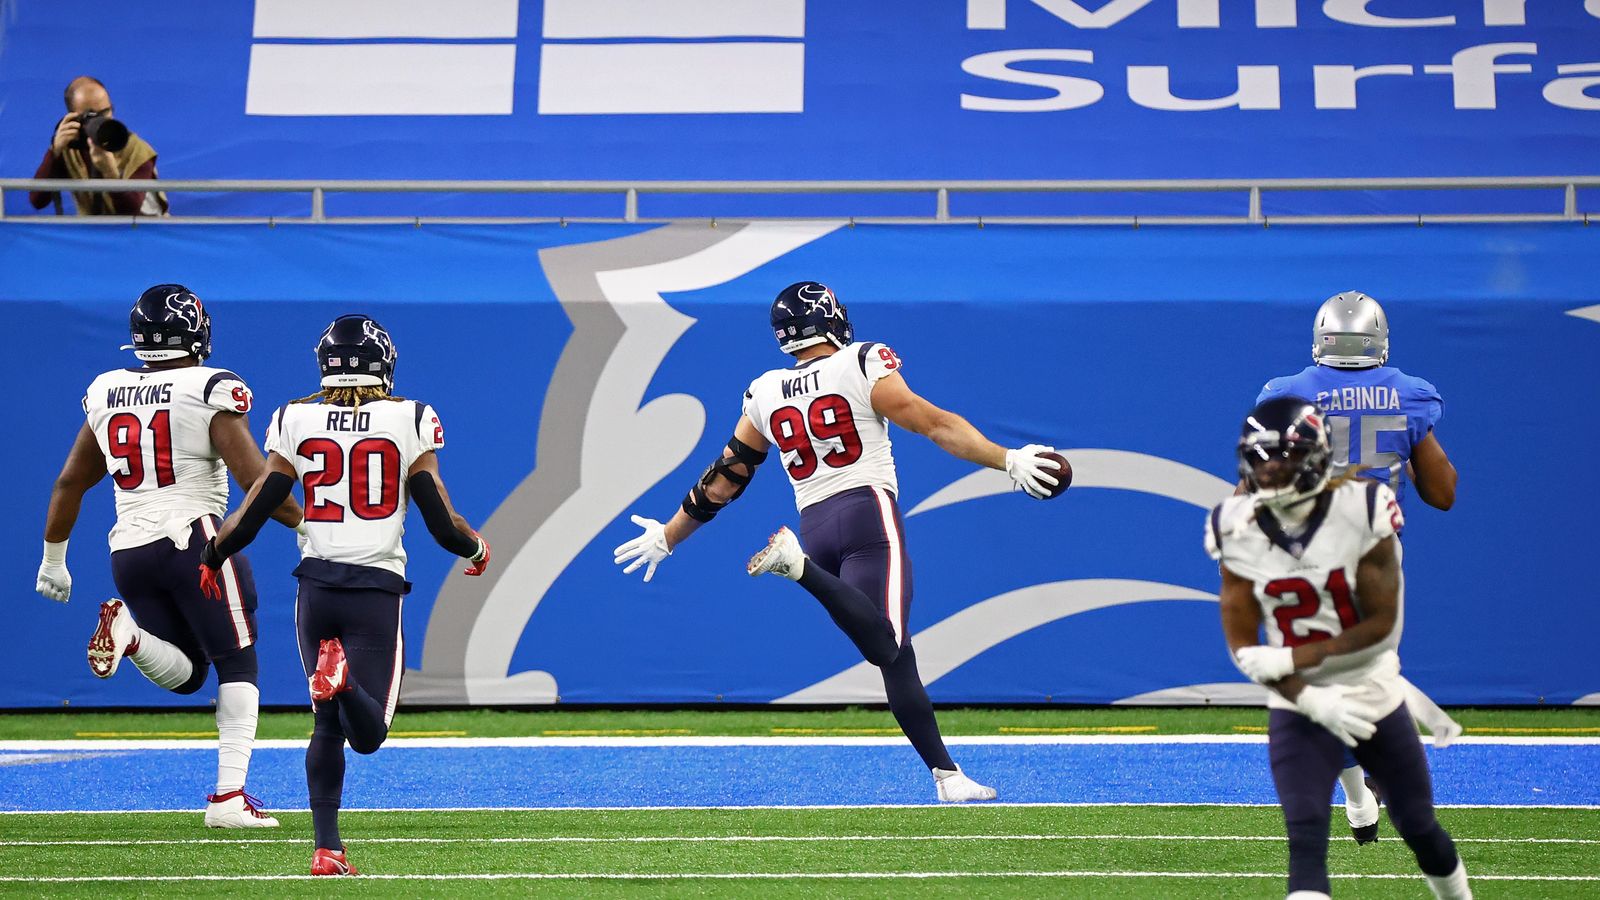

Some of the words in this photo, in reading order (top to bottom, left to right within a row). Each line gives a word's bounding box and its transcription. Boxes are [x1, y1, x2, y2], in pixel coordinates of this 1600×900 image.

[966, 0, 1600, 28] Micr
[878, 348, 902, 369] 9
[107, 383, 173, 408] WATKINS
[781, 370, 820, 399] WATT
[1317, 386, 1400, 411] CABINDA
[231, 386, 253, 412] 9
[326, 411, 370, 432] REID
[108, 409, 176, 490] 91
[770, 393, 863, 481] 99
[296, 437, 401, 523] 20
[1264, 567, 1361, 648] 21
